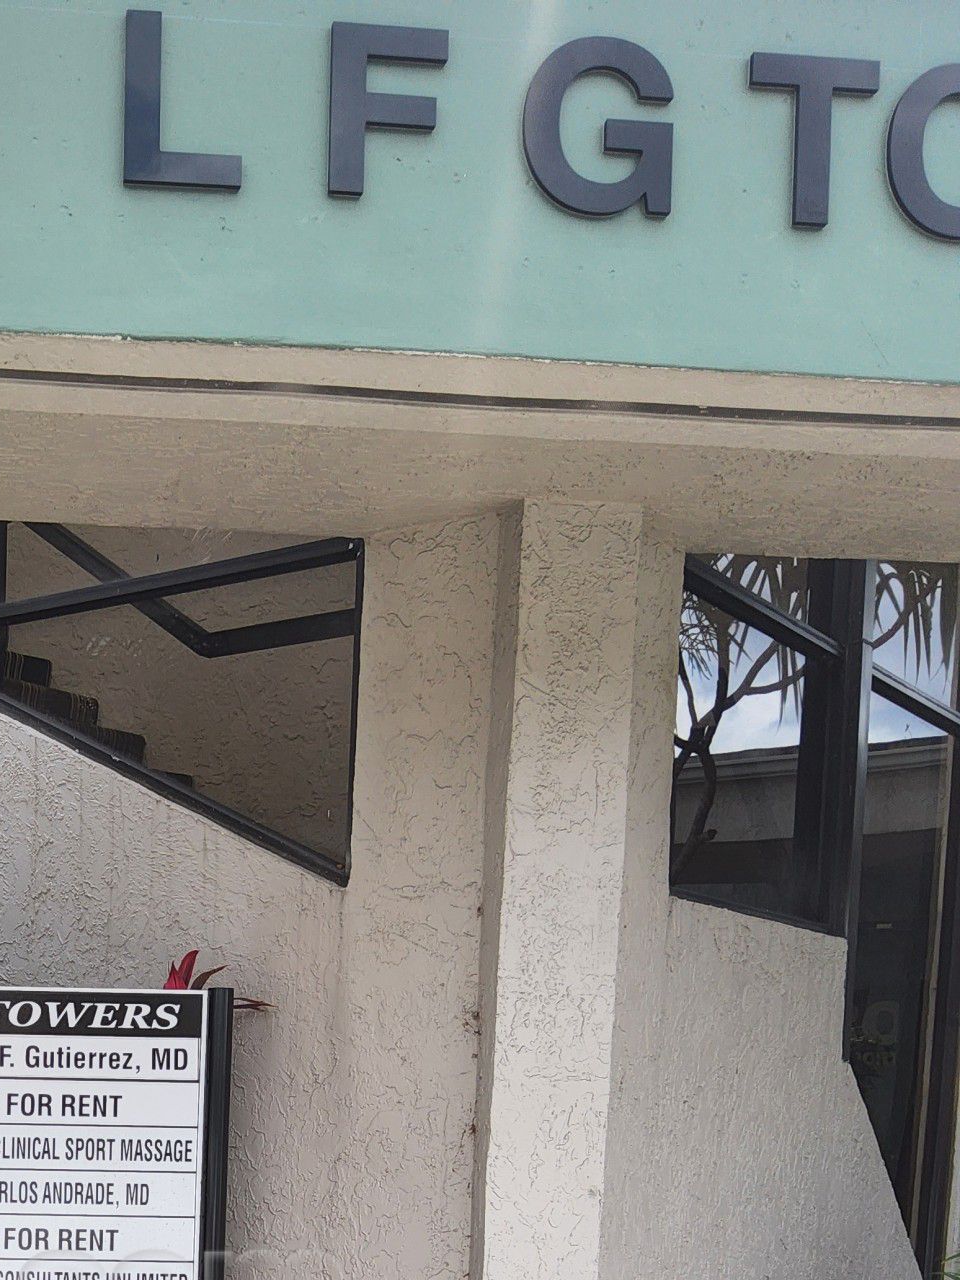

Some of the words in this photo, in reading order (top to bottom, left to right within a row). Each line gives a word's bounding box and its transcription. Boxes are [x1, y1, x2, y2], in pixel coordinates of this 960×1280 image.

[0, 1044, 16, 1068] F.
[25, 1044, 141, 1073] Gutierrez,
[151, 1047, 189, 1071] MD
[6, 1092, 52, 1117] FOR
[61, 1094, 123, 1118] RENT
[65, 1137, 116, 1161] SPORT
[120, 1138, 193, 1163] MASSAGE
[41, 1181, 120, 1208] ANDRADE,
[125, 1183, 150, 1206] MD
[4, 1227, 49, 1251] FOR
[58, 1228, 119, 1252] RENT
